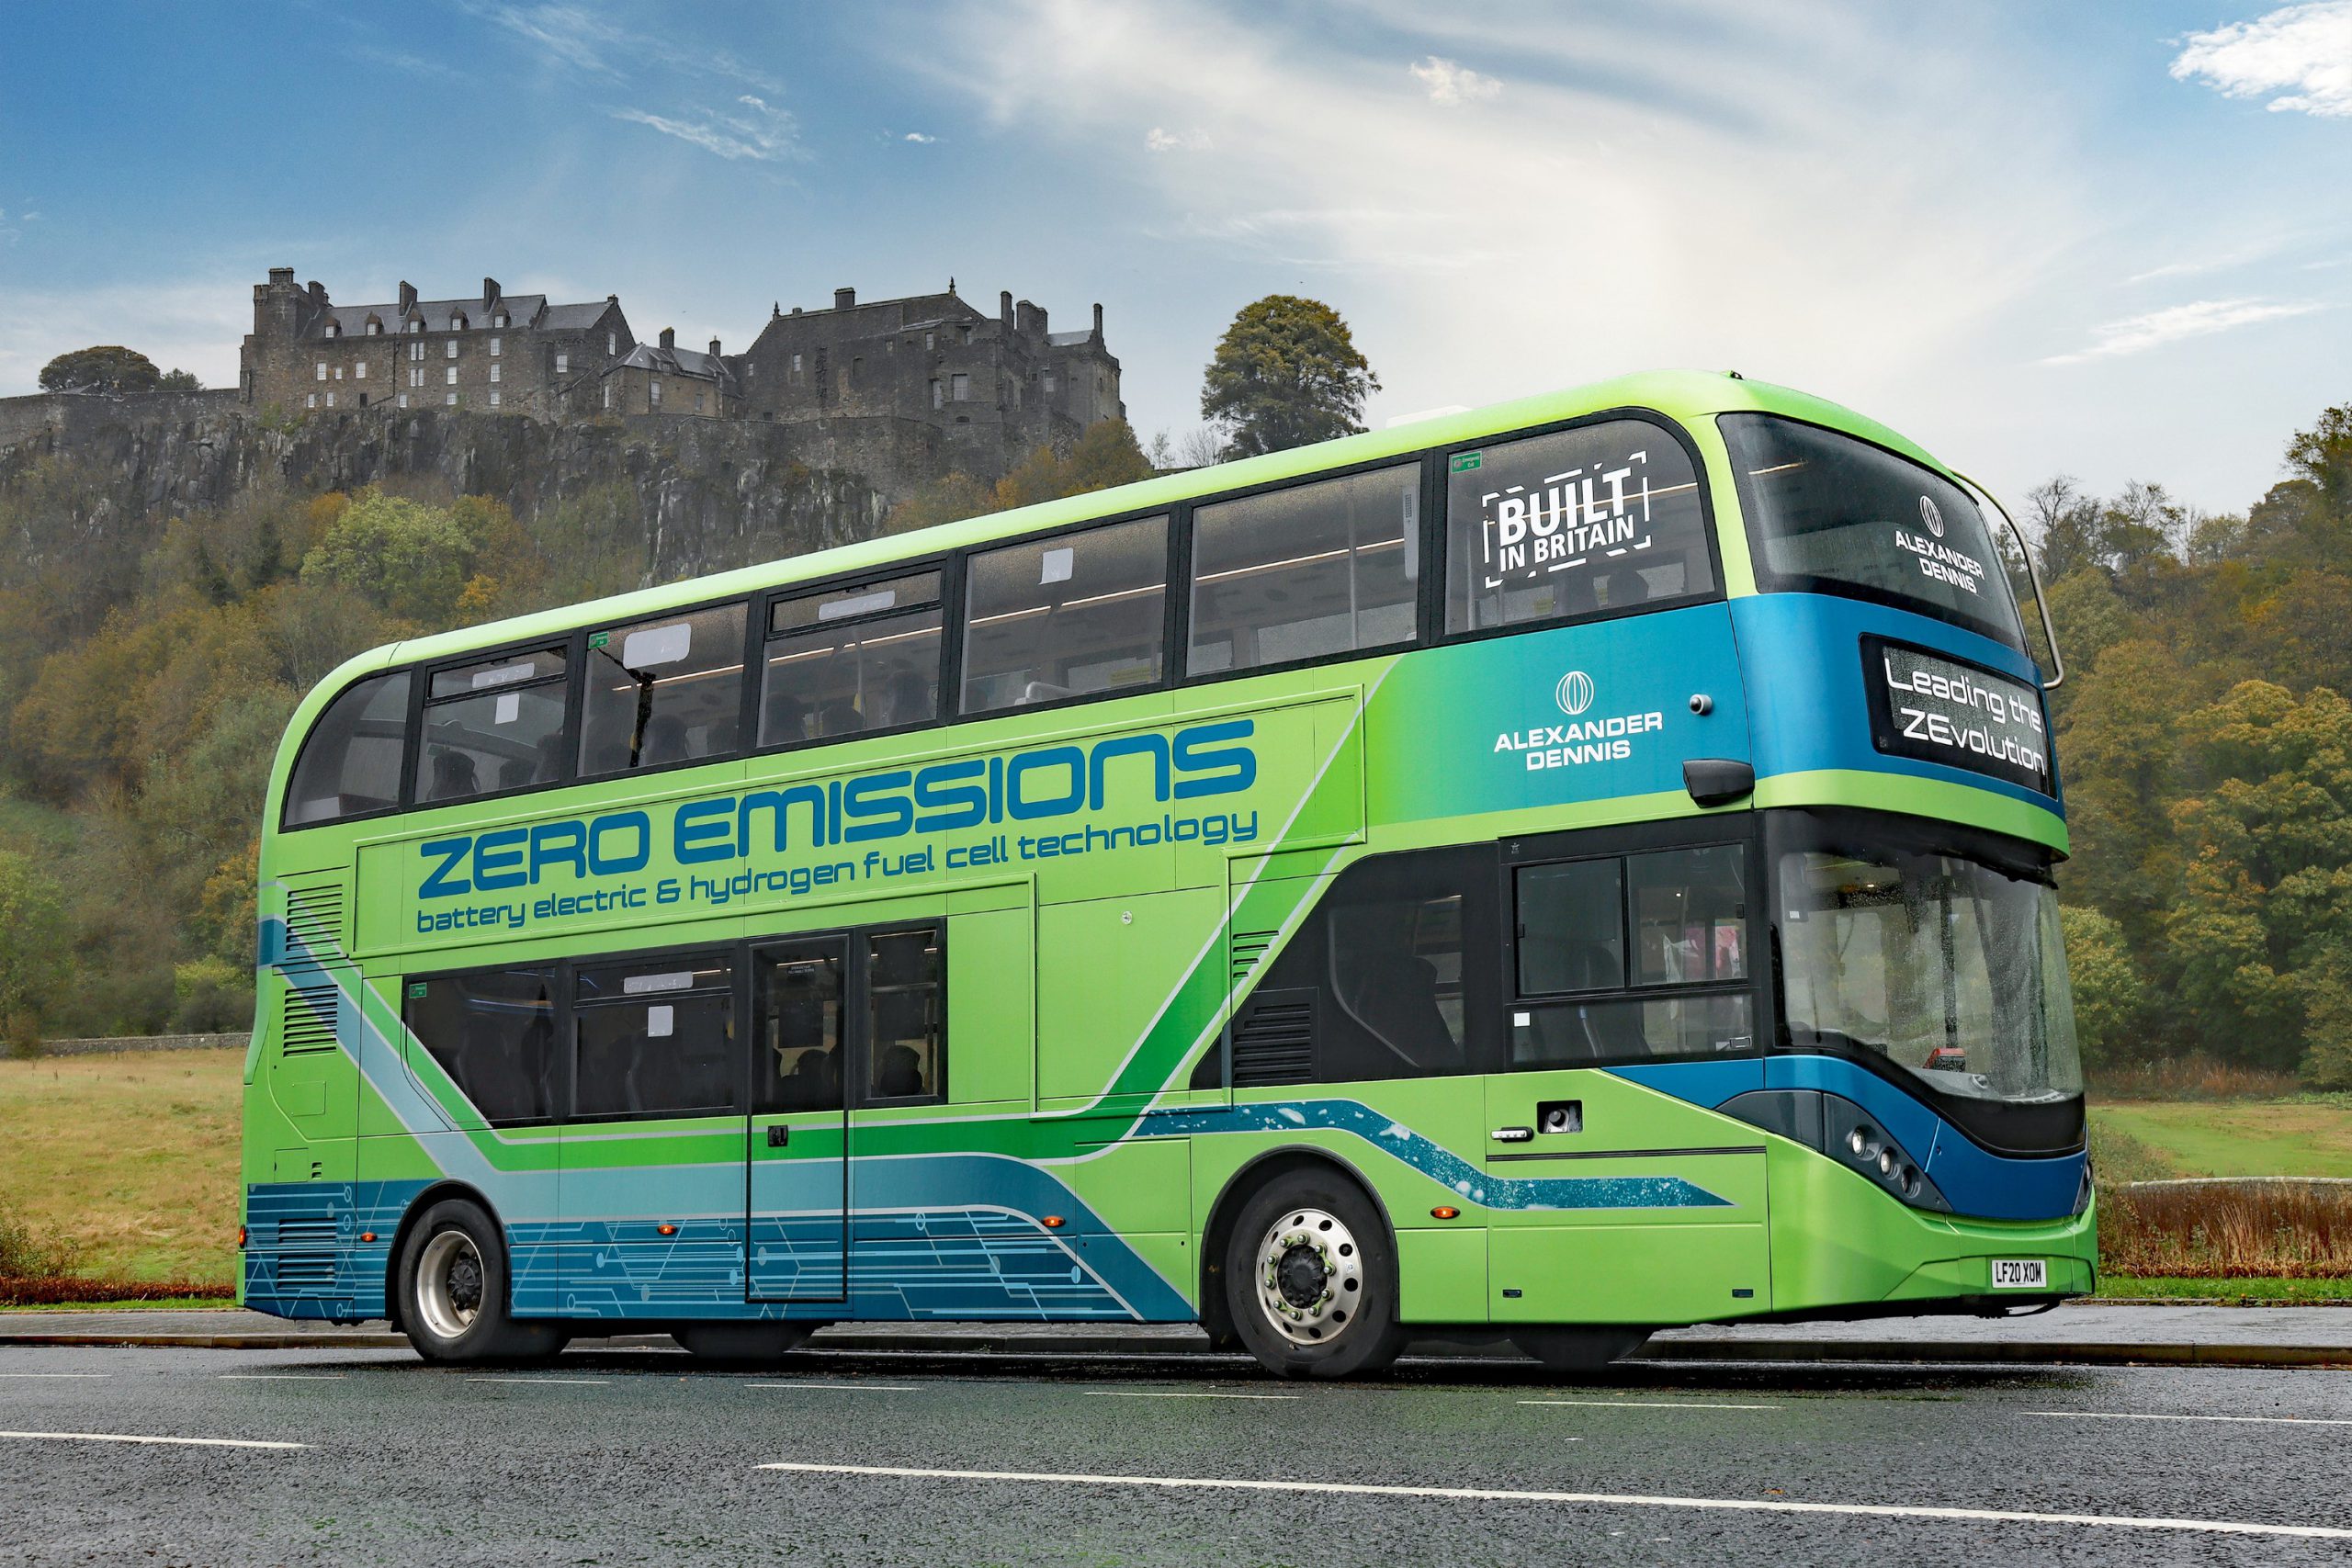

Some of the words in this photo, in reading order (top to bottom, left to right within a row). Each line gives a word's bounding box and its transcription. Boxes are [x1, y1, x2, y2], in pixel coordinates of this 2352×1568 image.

[1498, 467, 1632, 547] BUILT
[1499, 543, 1526, 572] IN
[1533, 513, 1635, 564] BRITAIN
[1894, 530, 1985, 581] ALEXANDER
[1919, 558, 1978, 594] DENNIS
[1884, 658, 2007, 724] Leading
[2008, 694, 2042, 734] the
[1494, 711, 1664, 752] ALEXANDER
[1526, 739, 1631, 772] DENNIS
[1900, 707, 2046, 776] ZEvolution
[416, 904, 526, 934] battery
[534, 888, 648, 919] electric
[656, 879, 682, 905] &
[691, 861, 856, 906] hydrogen
[864, 851, 935, 878] fuel
[945, 837, 1009, 869] cell
[1018, 811, 1259, 862] technology
[419, 811, 651, 899] ZERO
[1996, 1262, 2021, 1283] LF20
[2022, 1262, 2042, 1283] XOM
